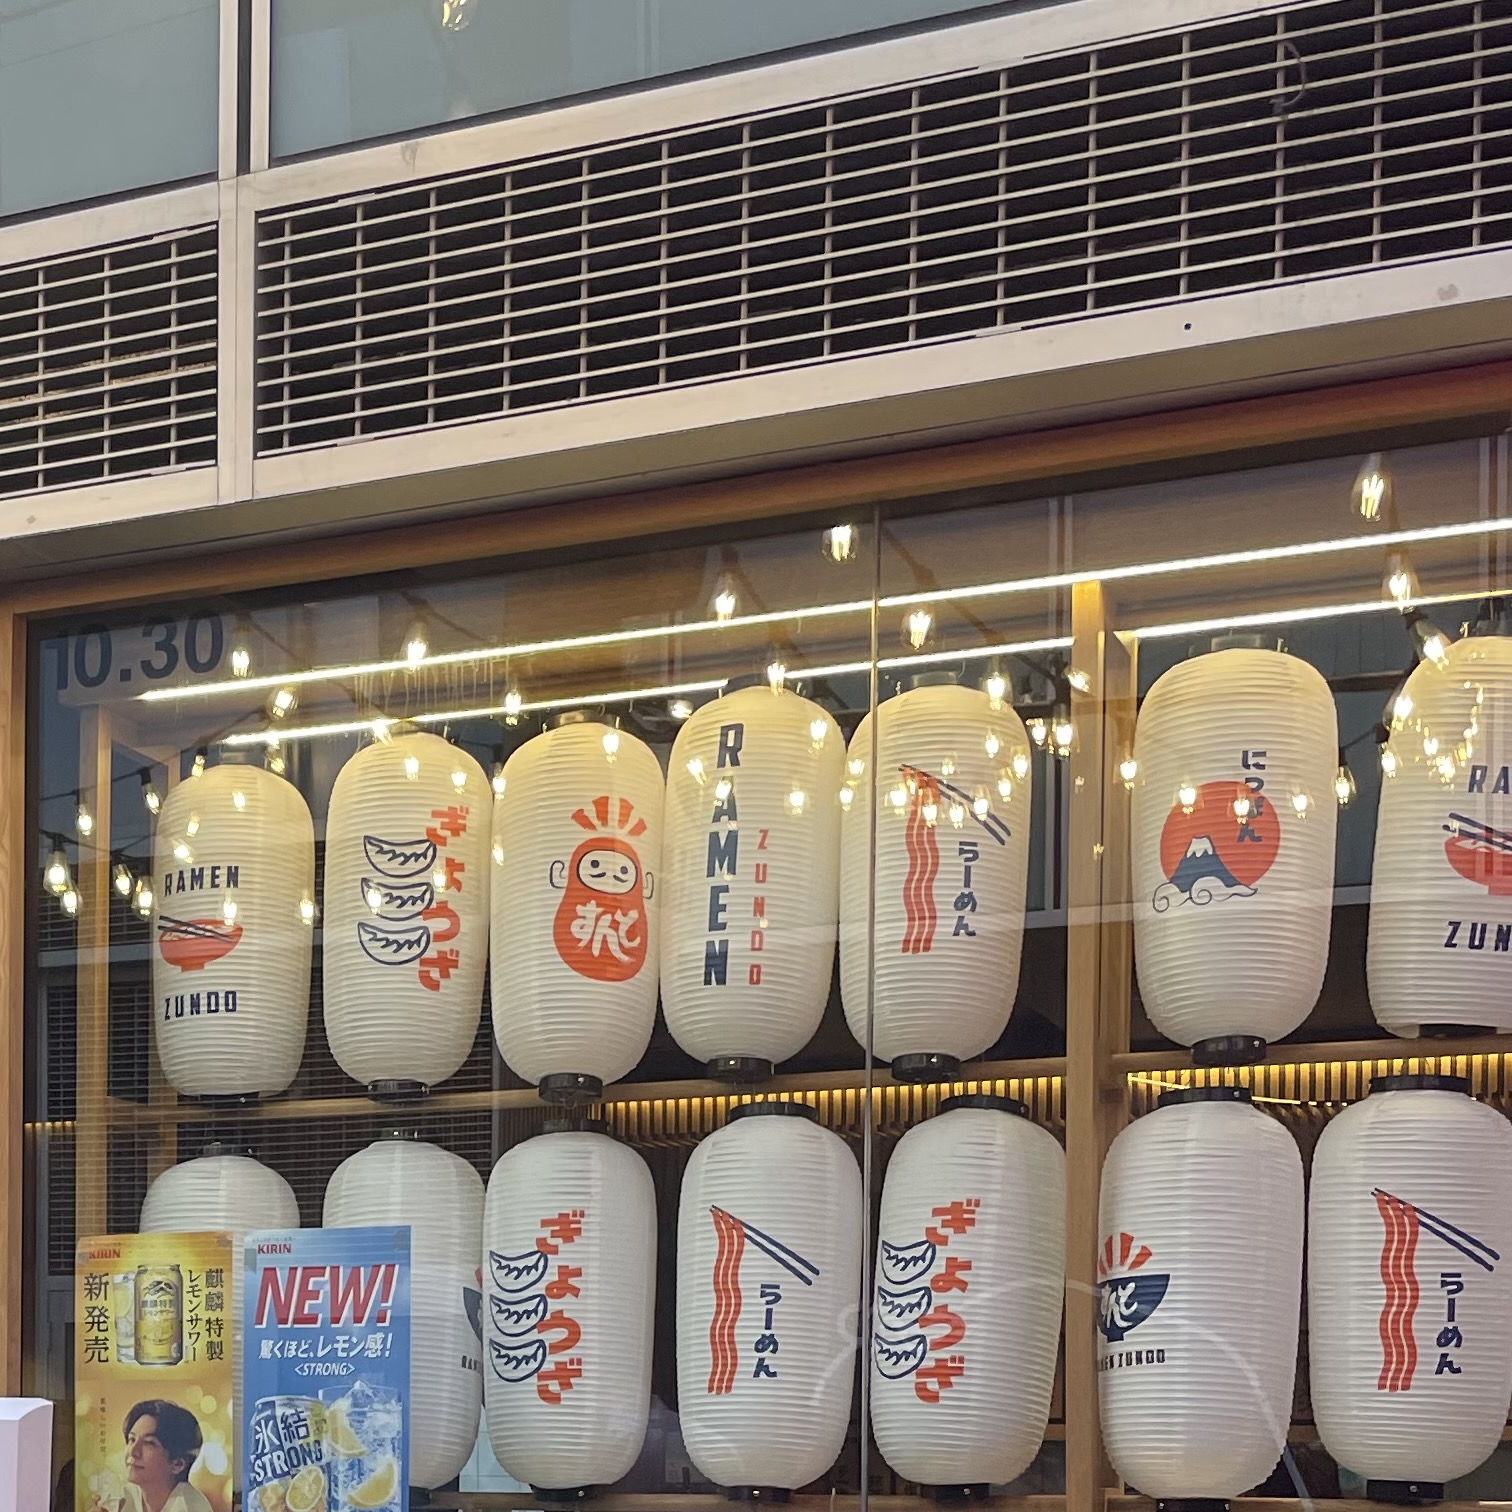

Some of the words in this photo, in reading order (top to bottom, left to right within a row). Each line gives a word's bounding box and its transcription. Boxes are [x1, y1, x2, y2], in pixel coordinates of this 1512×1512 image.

[45, 610, 223, 690] 10.30
[165, 866, 240, 897] RAMEN
[704, 723, 744, 986] RAMEN
[952, 841, 979, 936] らーめん
[749, 829, 769, 985] ZUNDO
[164, 990, 237, 1020] ZUNDO
[88, 1249, 121, 1259] KIRIN
[257, 1243, 292, 1255] KIRIN
[83, 1273, 109, 1363] 新発売
[185, 1269, 203, 1361] レモンサワー
[254, 1263, 397, 1328] NEW!
[753, 1283, 782, 1378] らーめん
[1435, 1272, 1464, 1375] らーめん
[253, 1439, 323, 1482] STRONG
[255, 1407, 310, 1454] 氷結
